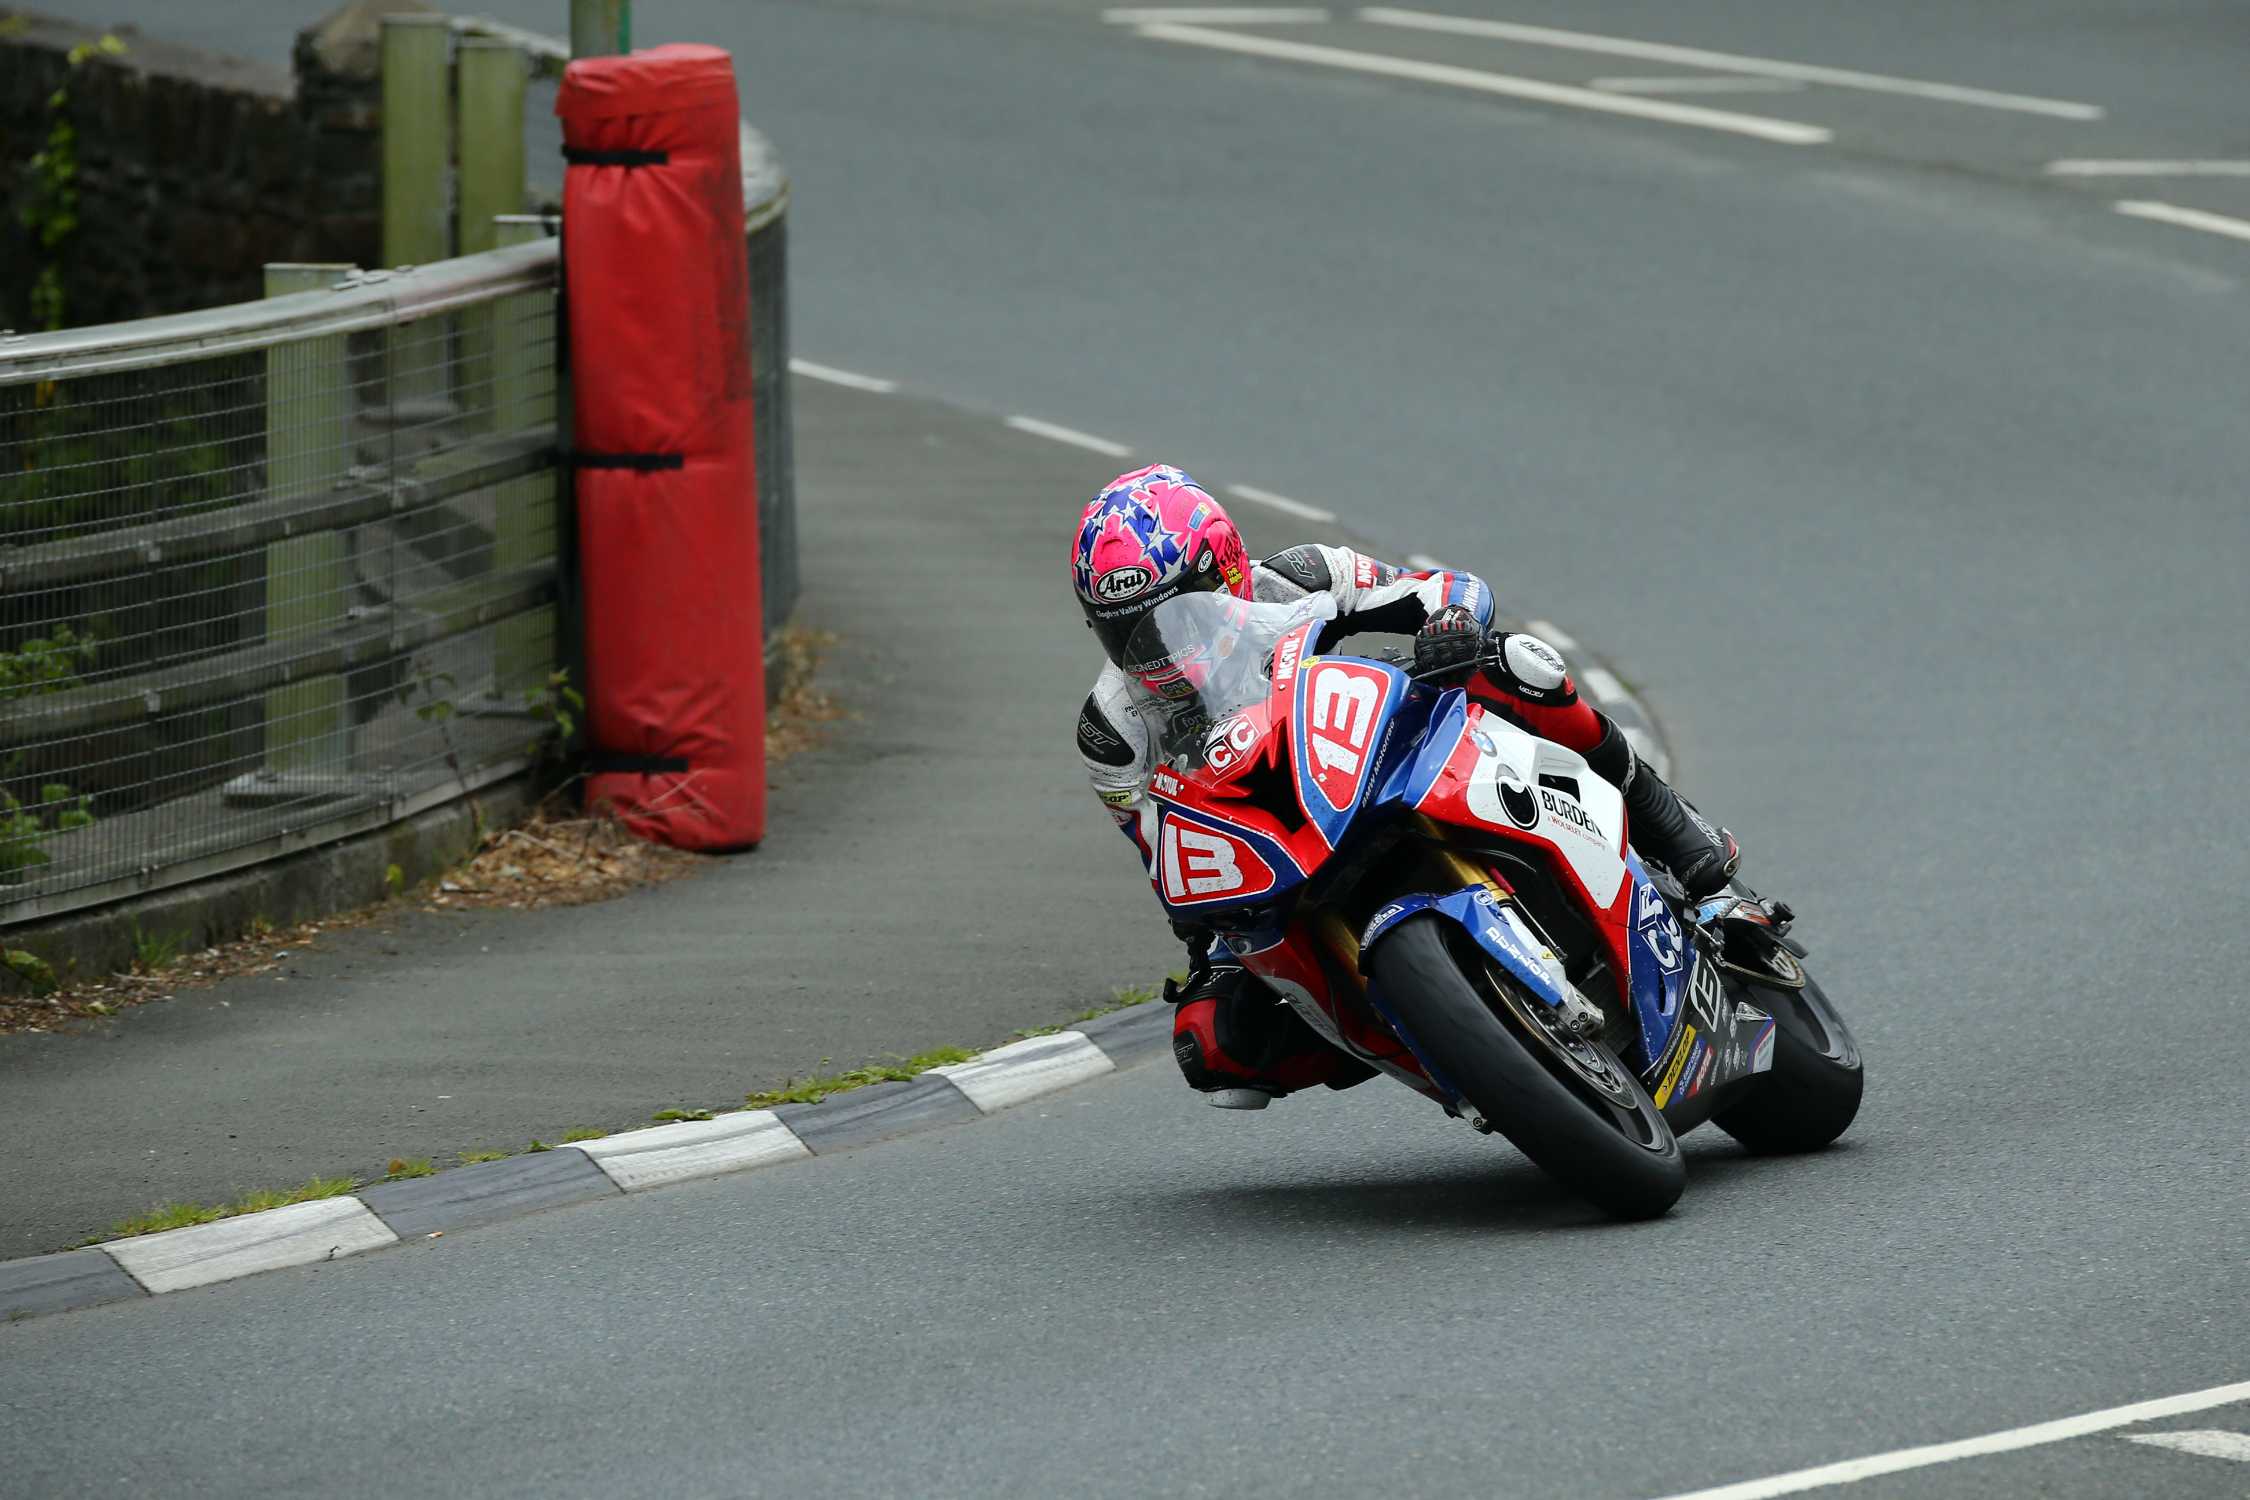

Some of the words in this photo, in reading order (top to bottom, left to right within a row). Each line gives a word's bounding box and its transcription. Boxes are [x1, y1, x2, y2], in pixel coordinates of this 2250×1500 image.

[1100, 570, 1145, 595] Arai
[1119, 603, 1143, 615] Valley
[1143, 586, 1179, 607] Windows
[1312, 667, 1379, 776] 13
[1541, 789, 1608, 842] BURDEN
[1163, 823, 1244, 898] 13
